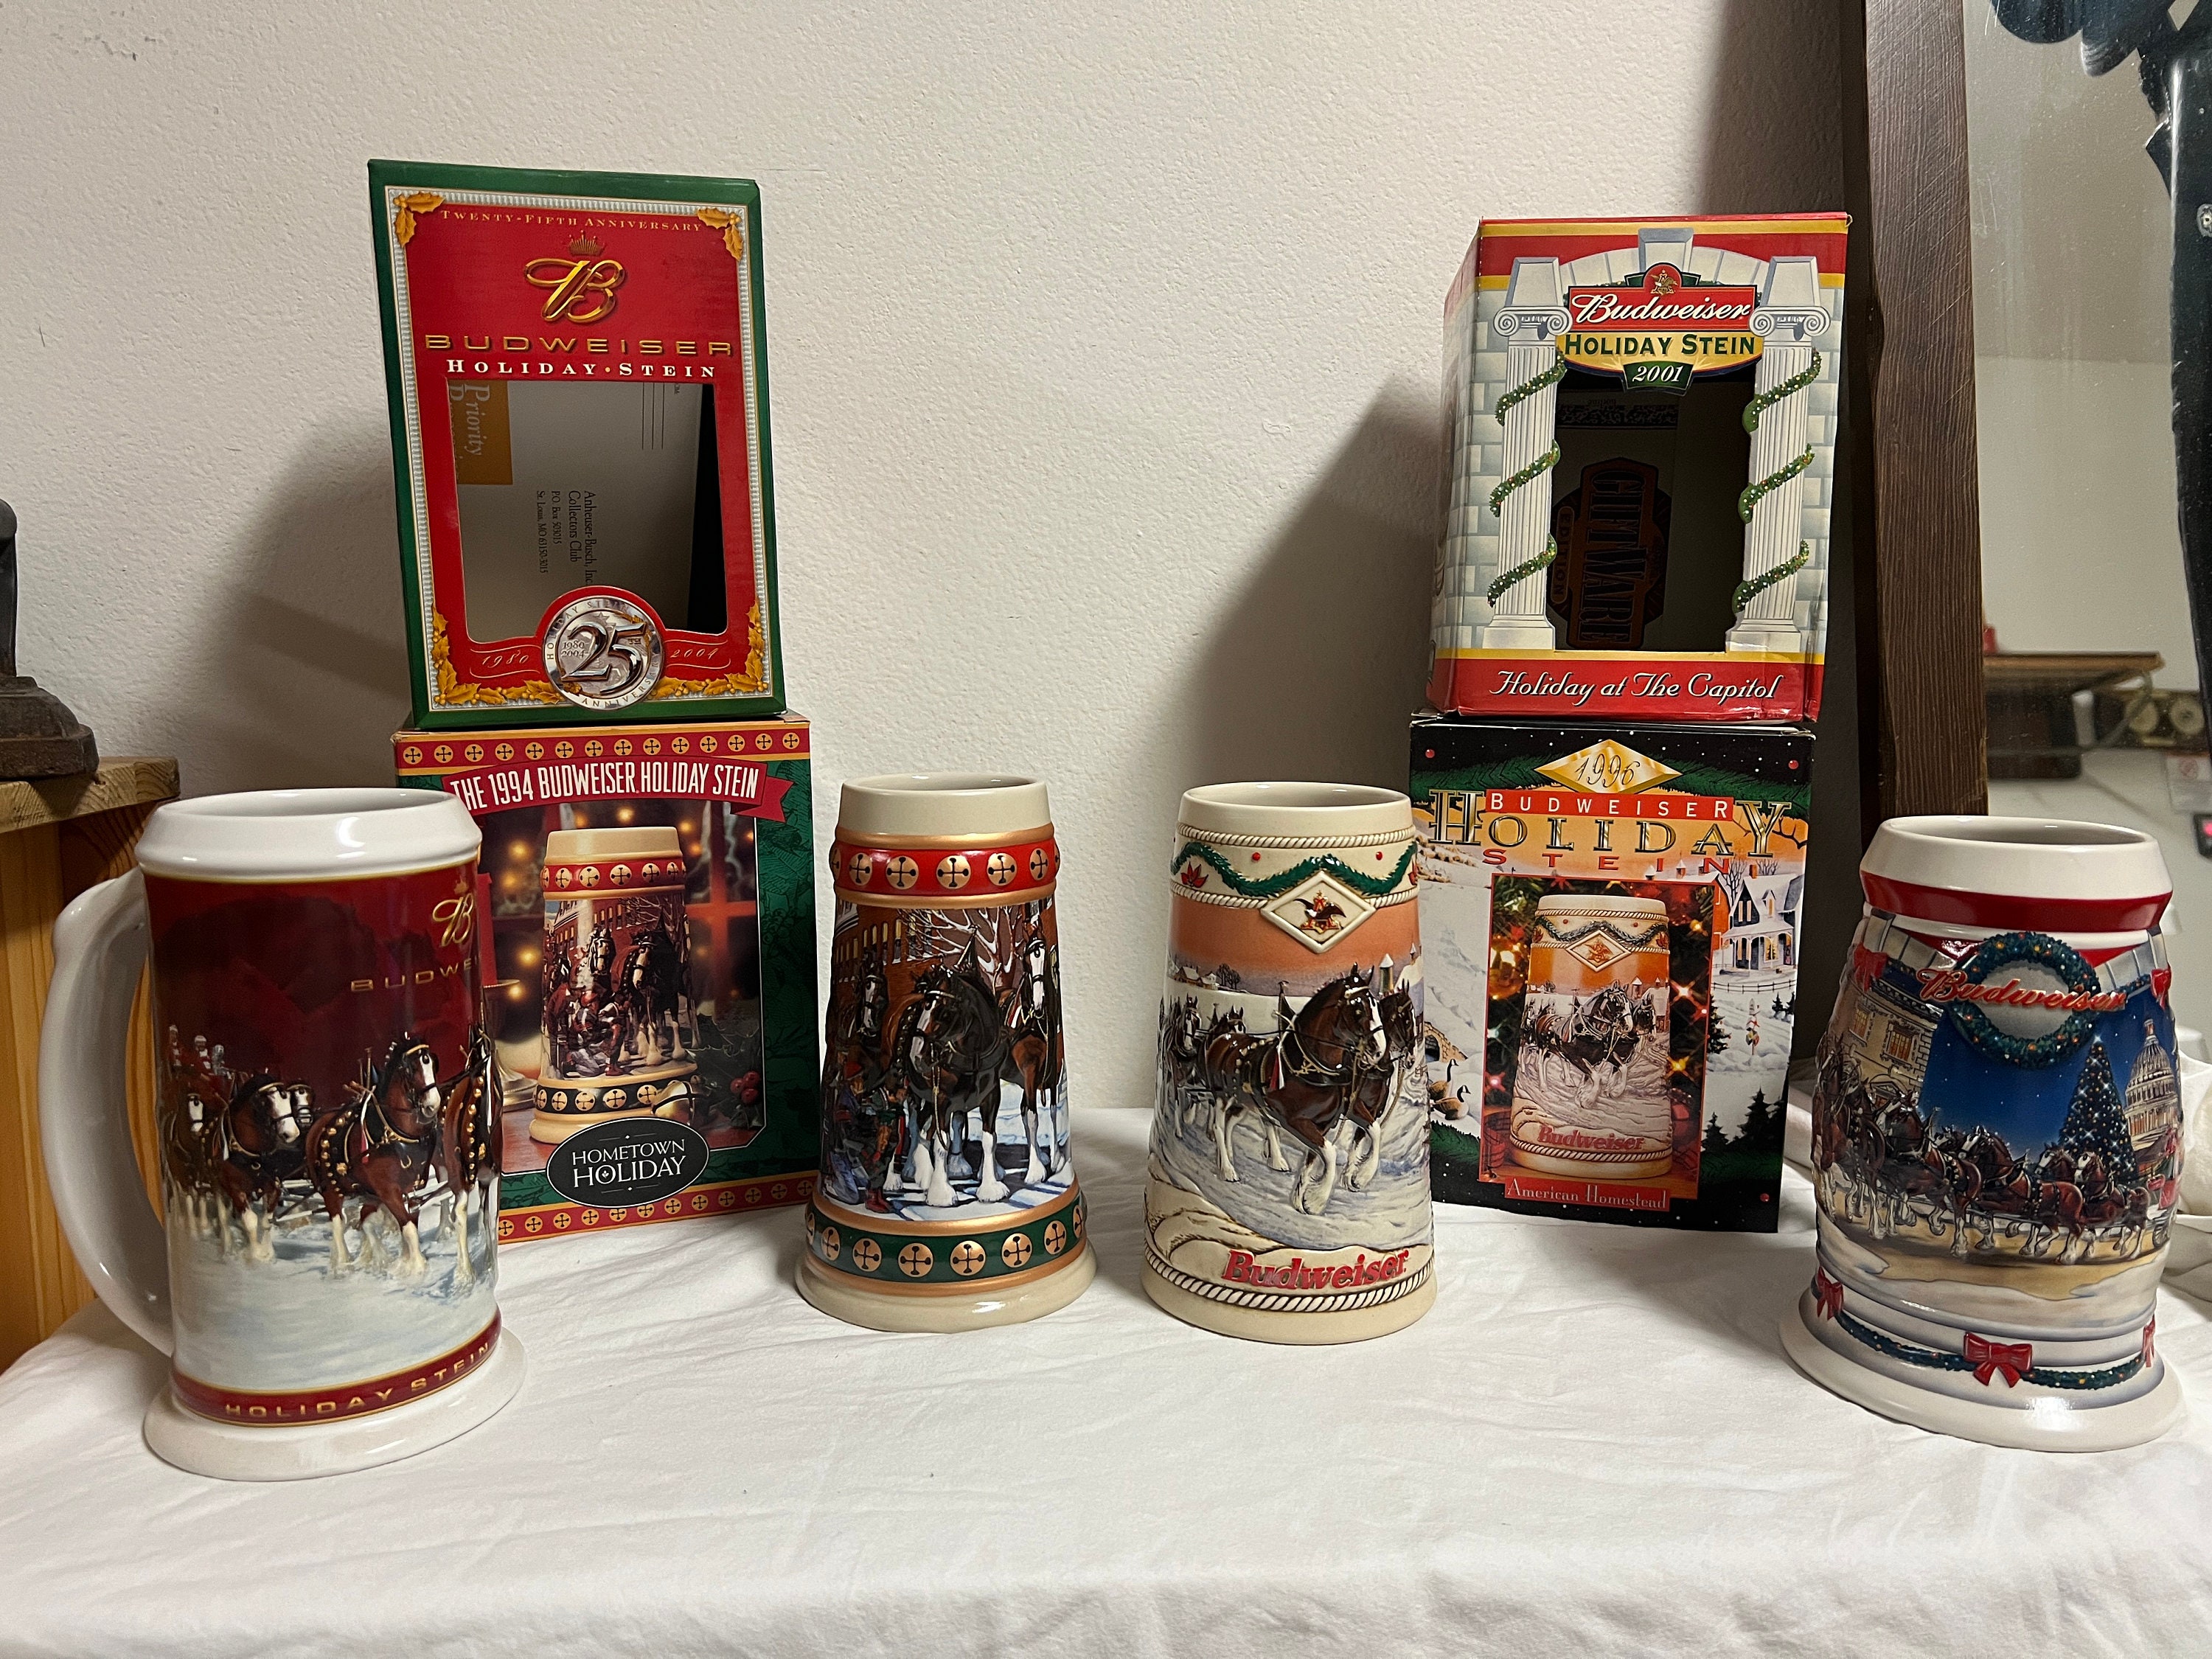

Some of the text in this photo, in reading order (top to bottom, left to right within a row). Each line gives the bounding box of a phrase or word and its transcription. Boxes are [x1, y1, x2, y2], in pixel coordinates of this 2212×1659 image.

[442, 209, 702, 232] TWENTY-FIFTH ANNIVERSARY
[1571, 293, 1751, 324] Budweiser
[425, 334, 734, 355] BUDWEISER
[1565, 333, 1755, 355] HOLIDAY STEIN
[1632, 365, 1685, 383] 2001
[464, 383, 490, 456] Priority
[552, 507, 561, 520] Box
[568, 490, 582, 563] Collectors Club
[584, 490, 597, 567] Anheuser-Busch,
[538, 523, 547, 536] MO
[552, 521, 562, 544] 503015
[481, 650, 529, 668] 1980
[560, 621, 647, 696] 25
[581, 653, 659, 706] ANNIVERSARY
[1489, 669, 1785, 706] Holiday at The Capitol
[449, 761, 760, 812] THE 1994 BUDWEISER HOLIDAY STEIN
[1574, 754, 1641, 789] 1996
[1489, 793, 1729, 819] BUDWEISER
[1427, 788, 1792, 858] HOLIDAY
[1481, 847, 1731, 875] STEIN
[1917, 968, 2127, 1011] Budweiser
[571, 1138, 686, 1166] HOMETOWN
[1536, 1122, 1644, 1152] Budweiser
[572, 1155, 687, 1189] HOLIDAY
[1507, 1178, 1666, 1209] American Homestead
[1221, 1249, 1410, 1290] Budweiser
[225, 1342, 490, 1418] HOLIDAY STEIN
